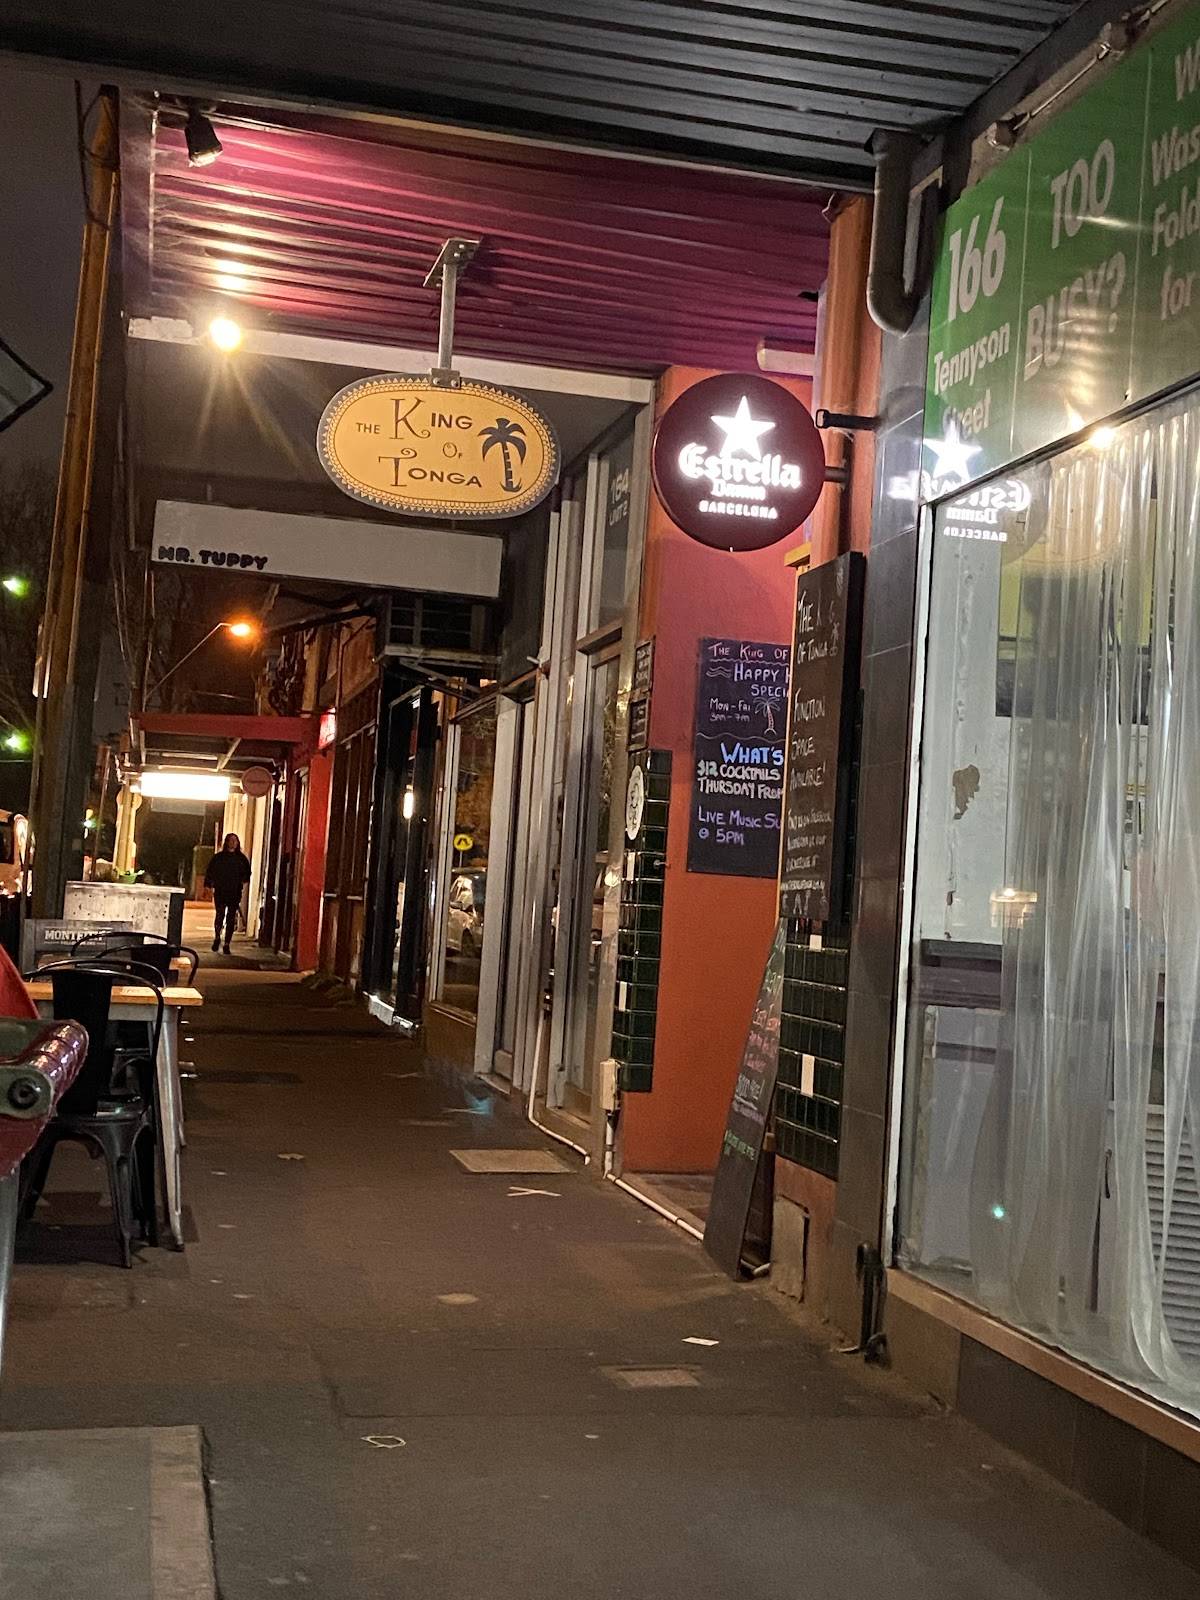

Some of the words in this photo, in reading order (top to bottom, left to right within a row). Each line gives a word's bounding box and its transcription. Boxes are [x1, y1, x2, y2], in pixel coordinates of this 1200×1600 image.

[1051, 139, 1115, 249] TOO
[948, 196, 1006, 322] 166
[934, 323, 1009, 395] Tennyson
[356, 422, 380, 434] THE
[389, 396, 473, 440] KING
[944, 388, 992, 440] reet
[378, 448, 482, 488] TONGA
[678, 442, 801, 489] Estrella
[698, 500, 778, 520] BARCELONA
[158, 546, 195, 563] MR.
[199, 549, 268, 571] TUPPY
[708, 642, 730, 657] THE
[774, 648, 789, 660] OF
[734, 662, 779, 682] HAPPY
[721, 742, 784, 766] WHAT'S
[697, 759, 718, 777] $12
[720, 764, 780, 781] COCKTAILS
[698, 776, 755, 798] THURSDAY
[699, 805, 726, 825] LIVE
[729, 810, 761, 828] MUSIC
[716, 828, 744, 845] 5PM
